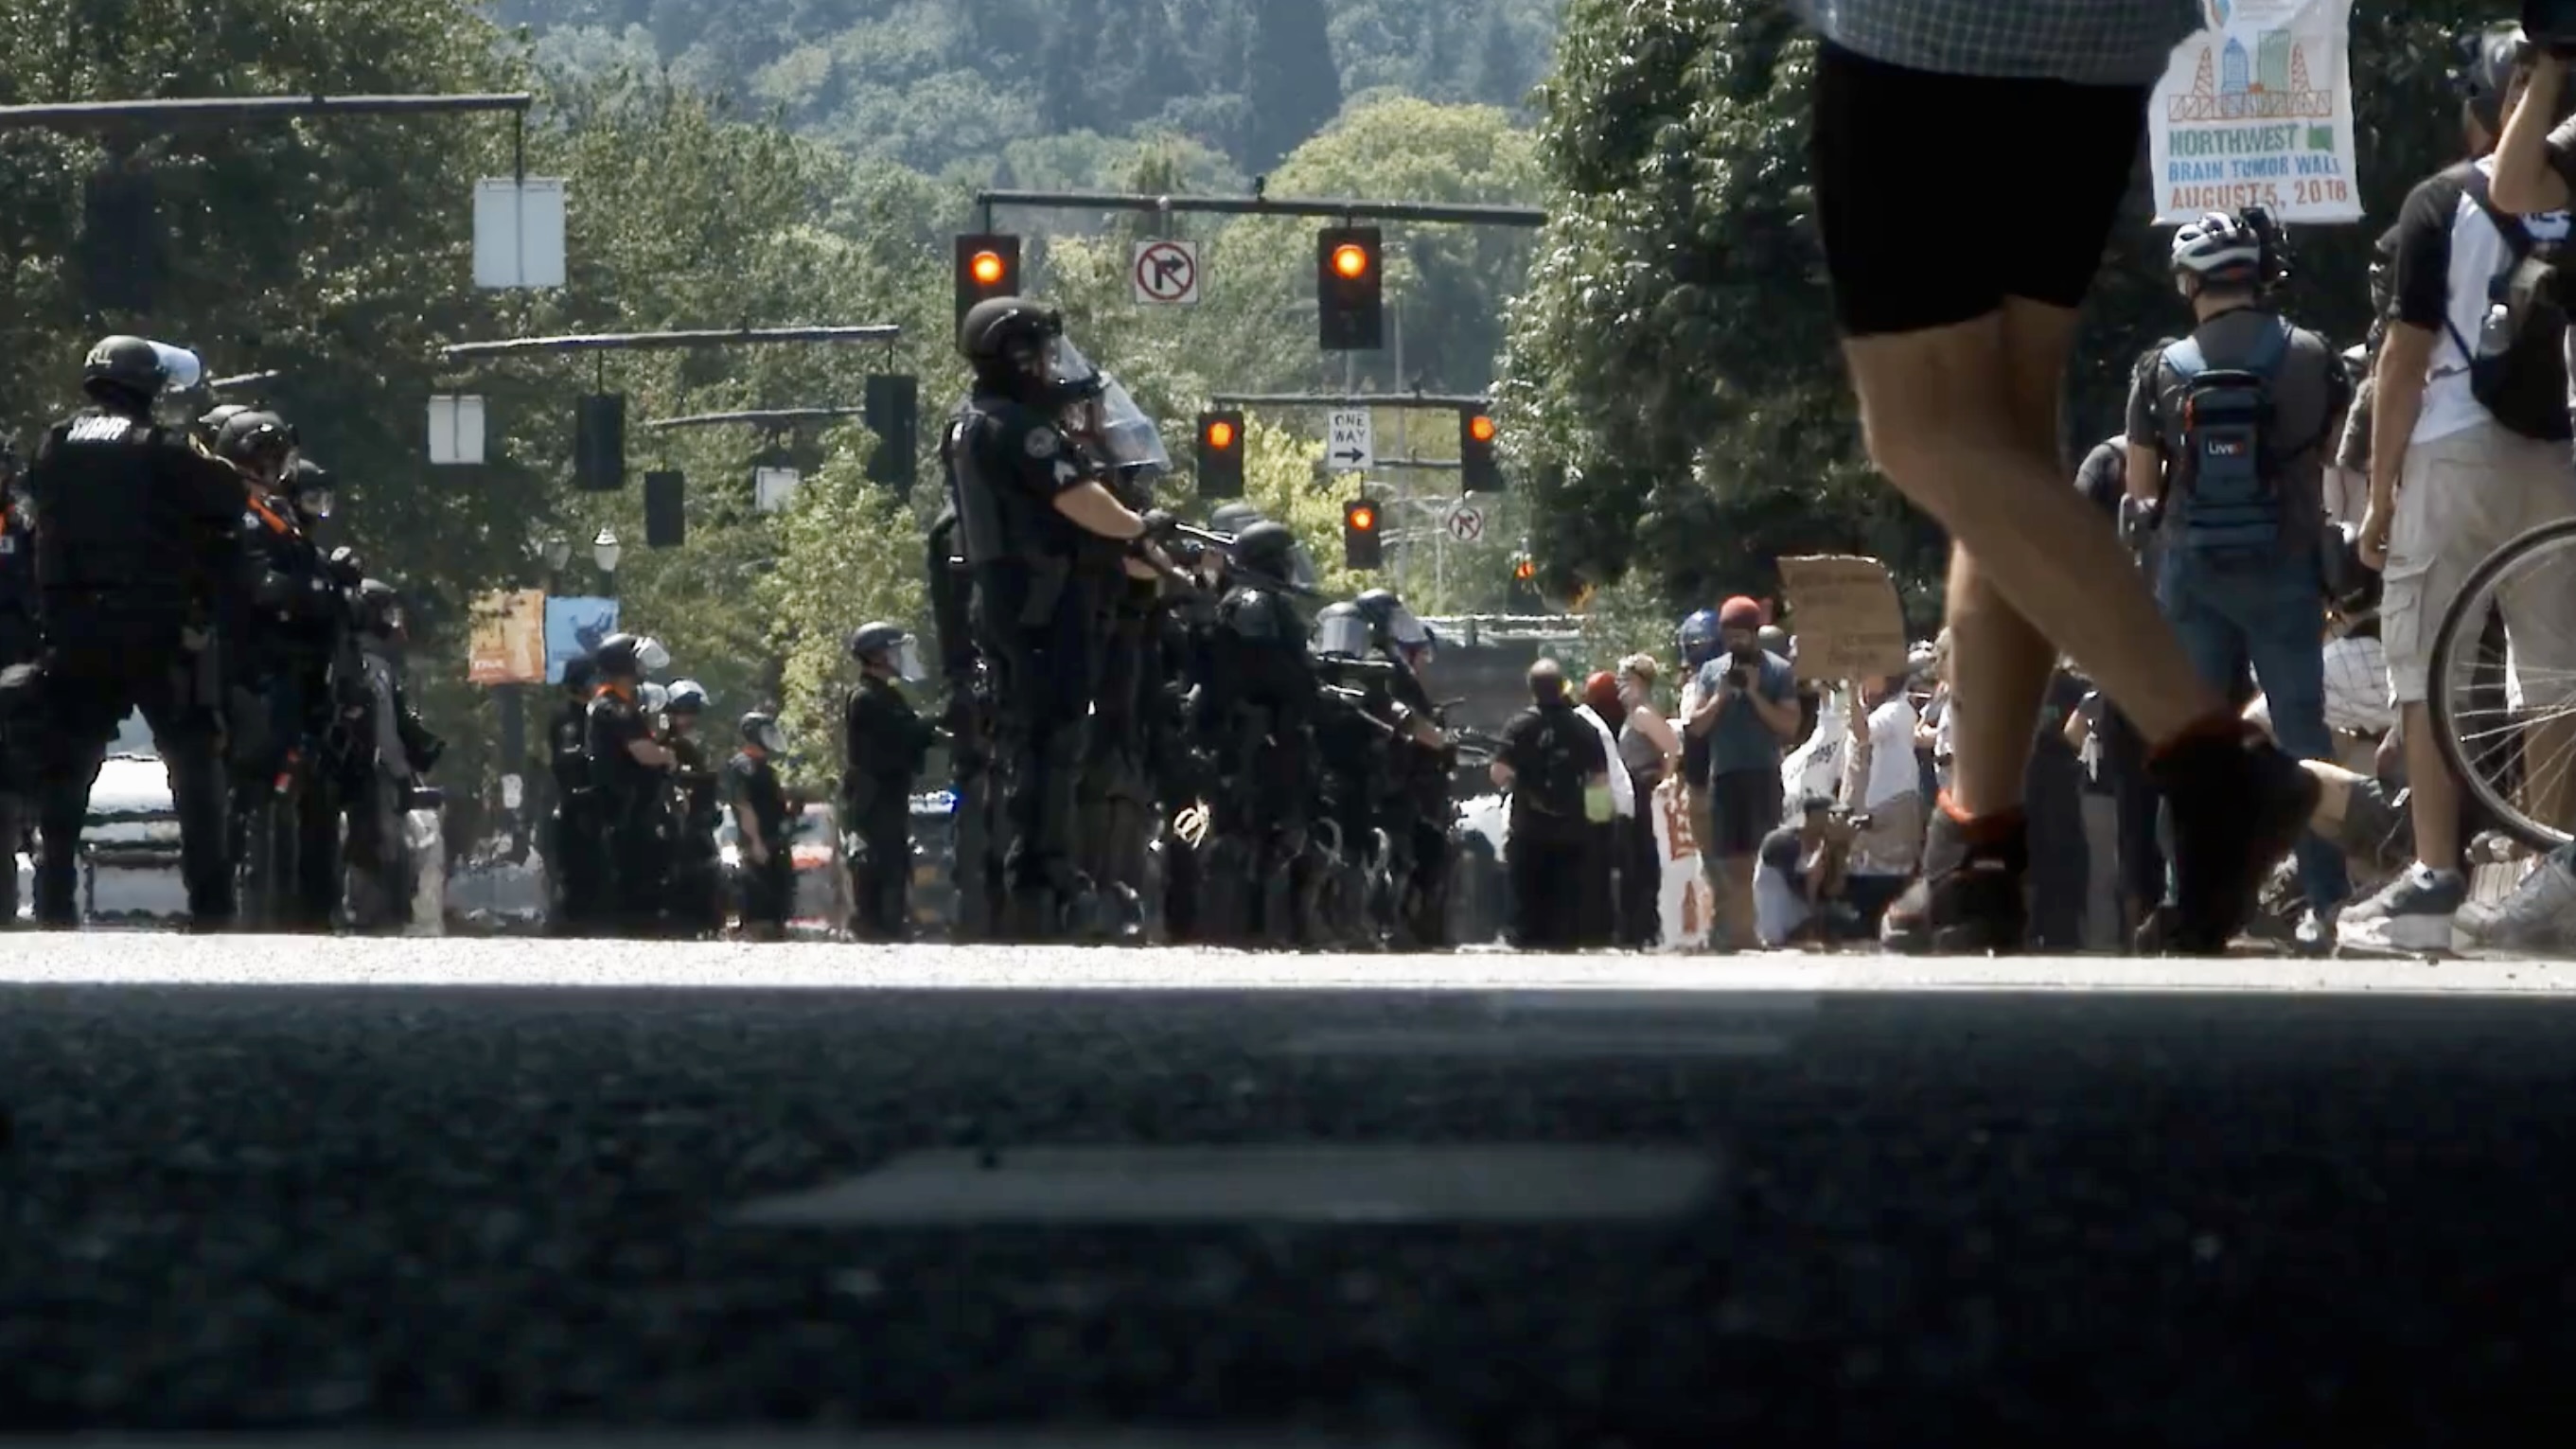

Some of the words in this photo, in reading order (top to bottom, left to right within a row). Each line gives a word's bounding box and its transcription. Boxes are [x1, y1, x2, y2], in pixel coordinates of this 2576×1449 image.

[2168, 123, 2300, 156] NORTHWEST
[2168, 160, 2224, 183] BRAIN
[2232, 156, 2289, 178] TUMOR
[2170, 182, 2261, 211] AUGUST
[2294, 179, 2348, 205] 2018
[1334, 414, 1365, 427] ONE
[1334, 429, 1366, 443] WAY
